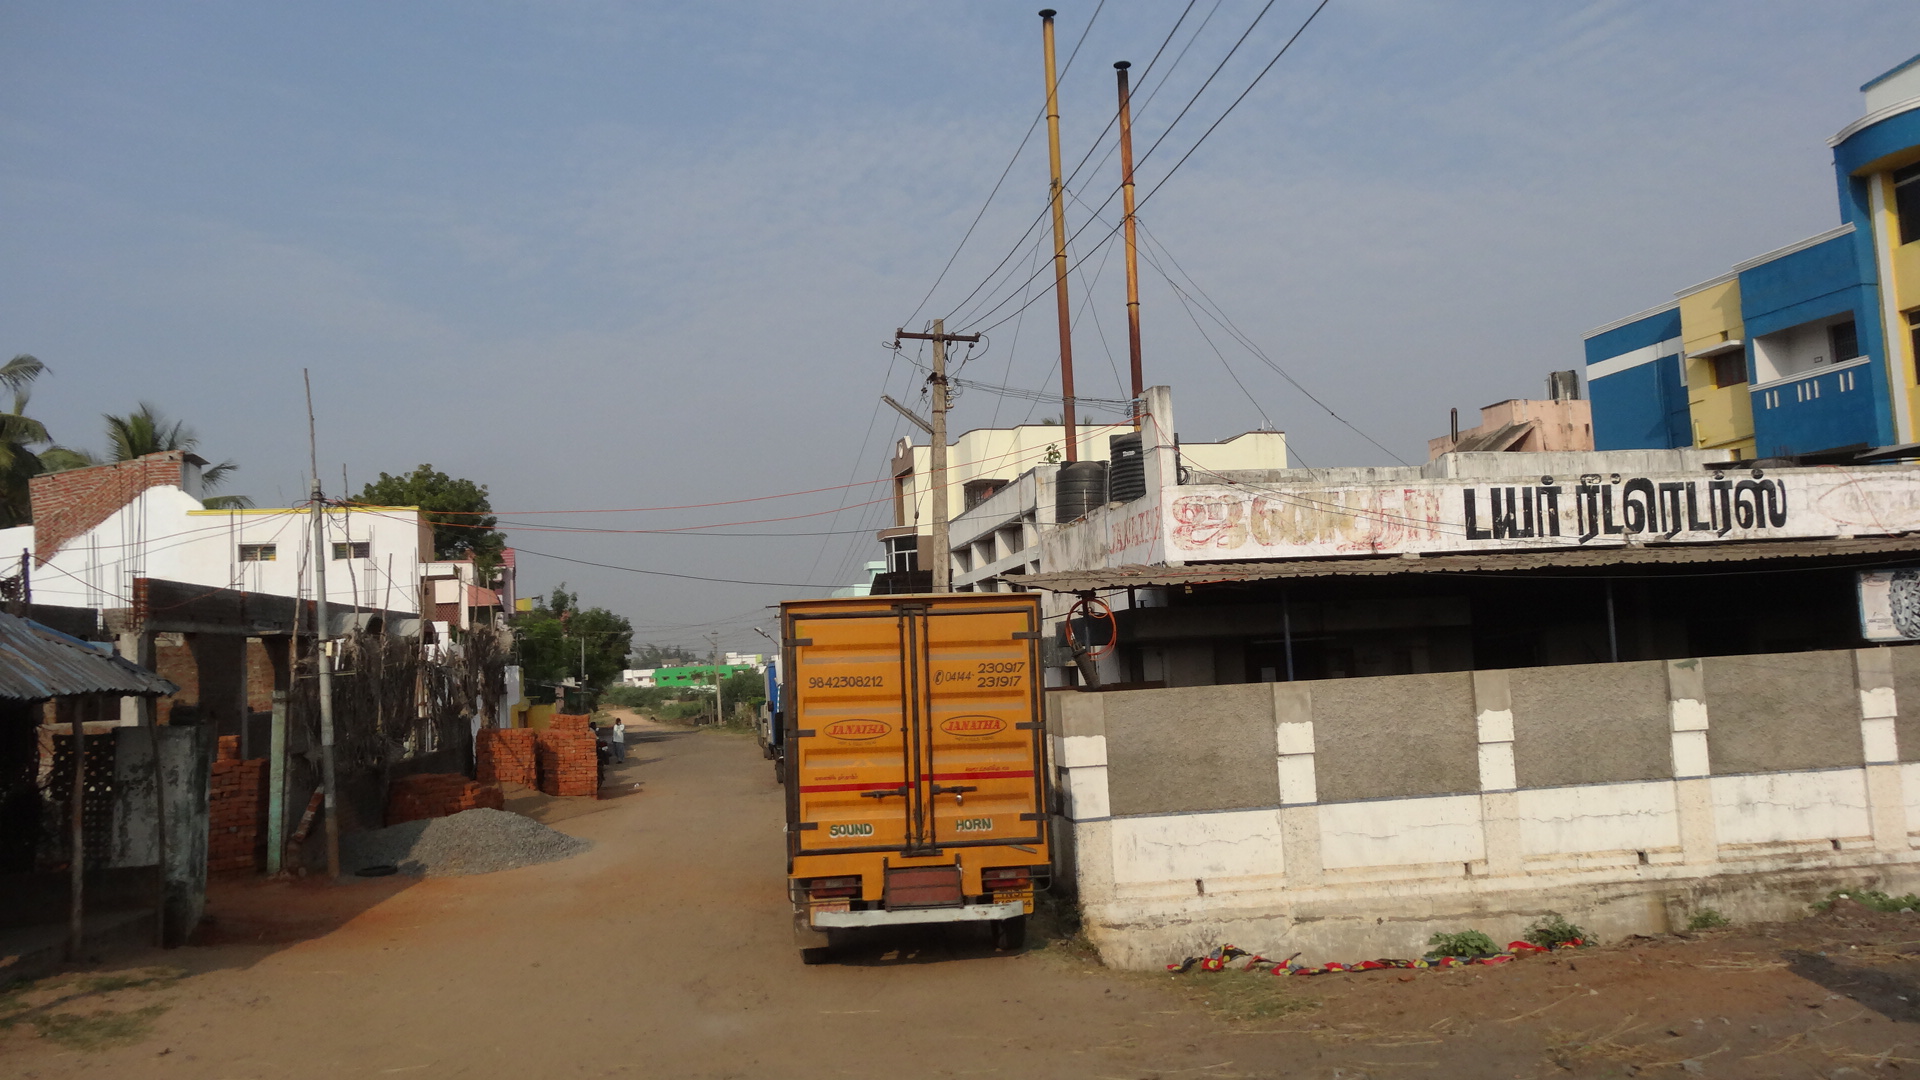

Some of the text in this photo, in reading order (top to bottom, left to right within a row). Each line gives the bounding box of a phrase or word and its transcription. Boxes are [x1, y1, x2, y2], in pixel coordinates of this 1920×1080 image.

[1463, 475, 1562, 540] டயர்
[977, 662, 1025, 674] 230917
[808, 676, 884, 688] 9842308212
[977, 676, 1021, 688] 231917
[828, 724, 886, 735] JANATHA
[944, 720, 1001, 731] JANATHA
[829, 823, 874, 838] SOUND
[956, 818, 993, 832] HORN
